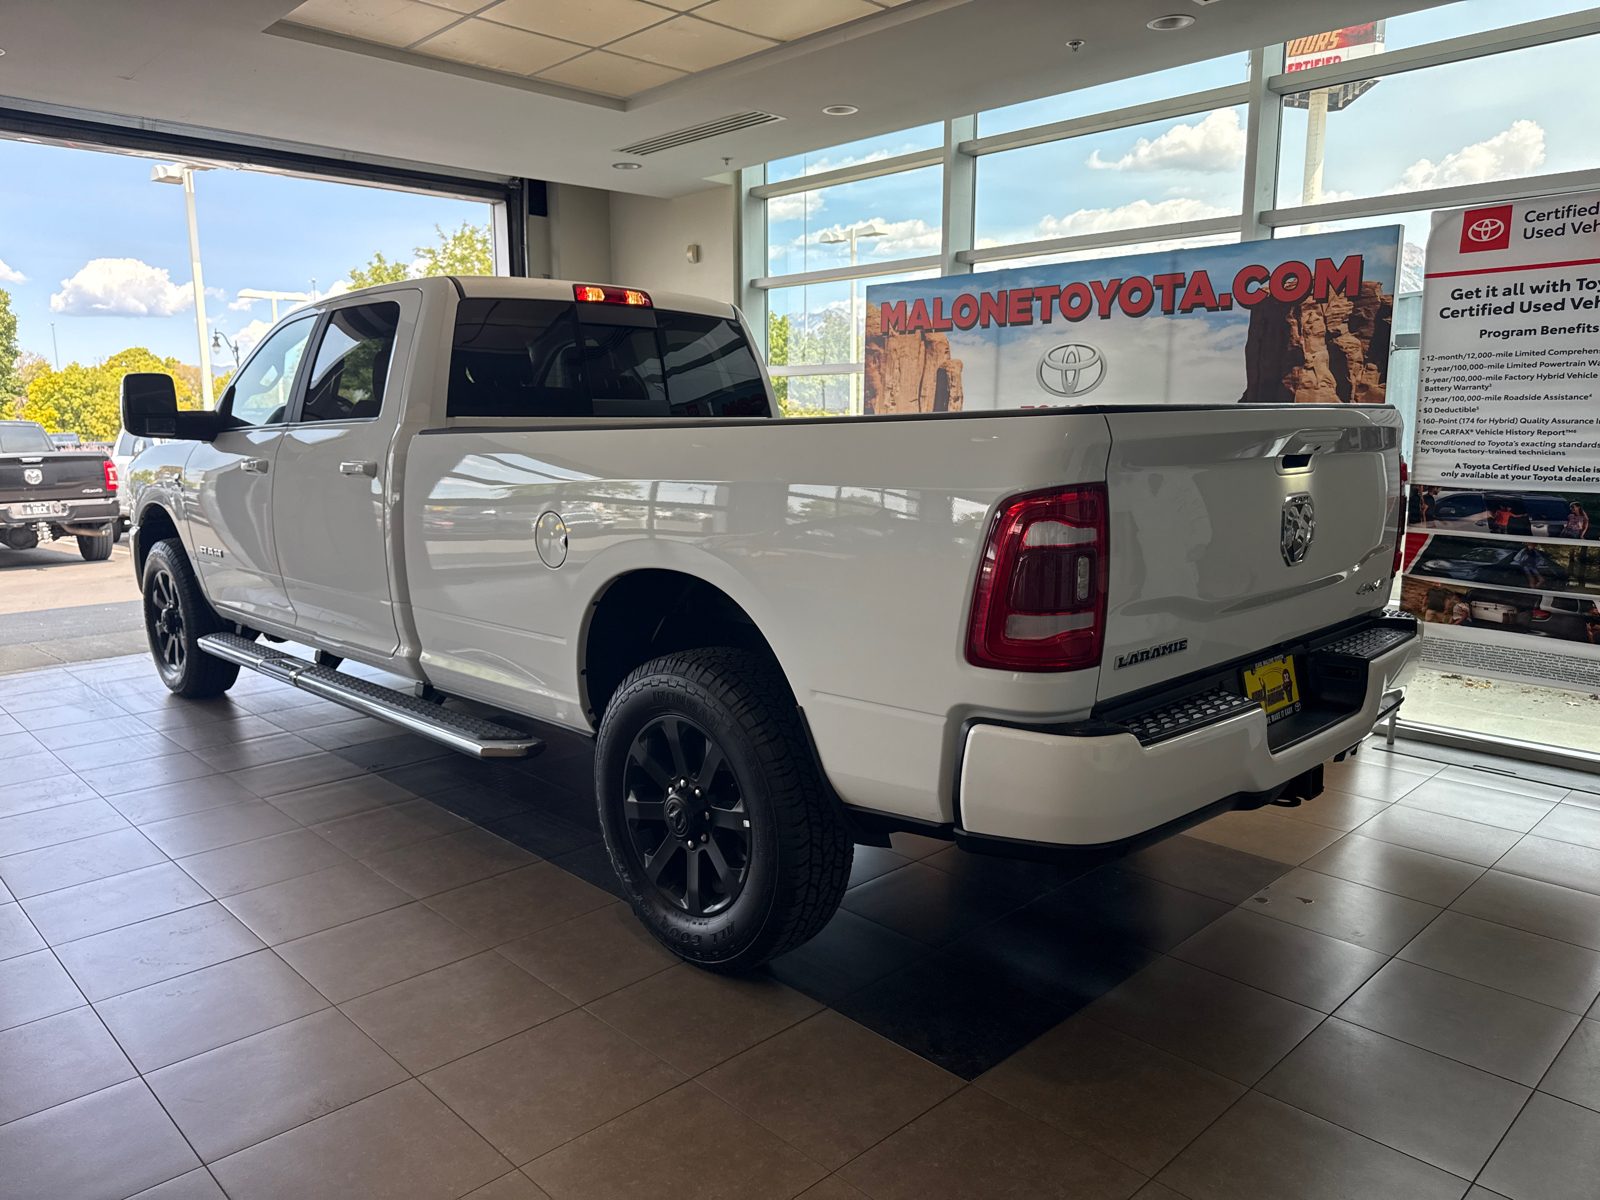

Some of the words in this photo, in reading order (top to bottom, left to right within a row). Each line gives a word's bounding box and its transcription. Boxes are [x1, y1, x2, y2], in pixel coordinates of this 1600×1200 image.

[1286, 56, 1342, 72] ERTIFIED
[1524, 201, 1600, 222] Certified
[1523, 223, 1566, 240] Used
[880, 254, 1364, 335] MALONETOYOTA.COM
[1450, 287, 1482, 300] Get
[1486, 286, 1498, 298] it
[1502, 282, 1525, 296] all
[1530, 279, 1570, 294] with
[1576, 278, 1600, 292] To
[1439, 302, 1514, 319] Certified
[1519, 298, 1566, 314] Used
[1480, 327, 1536, 340] Program
[1540, 323, 1600, 336] Benefits
[1426, 351, 1513, 361] 12-month/12,000-mile
[1426, 363, 1504, 373] 7-year/100,000-mile
[1425, 374, 1502, 384] 8-year/100,000-mile
[1536, 373, 1565, 381] Hybrid
[1424, 394, 1502, 403] 7-year/100,000-mile
[1520, 417, 1550, 425] Quality
[1533, 474, 1563, 482] Toyota
[199, 546, 224, 558] RAM
[1114, 638, 1188, 670] LARAMIE
[652, 690, 720, 732] IRONMAN
[710, 921, 735, 944] ALL
